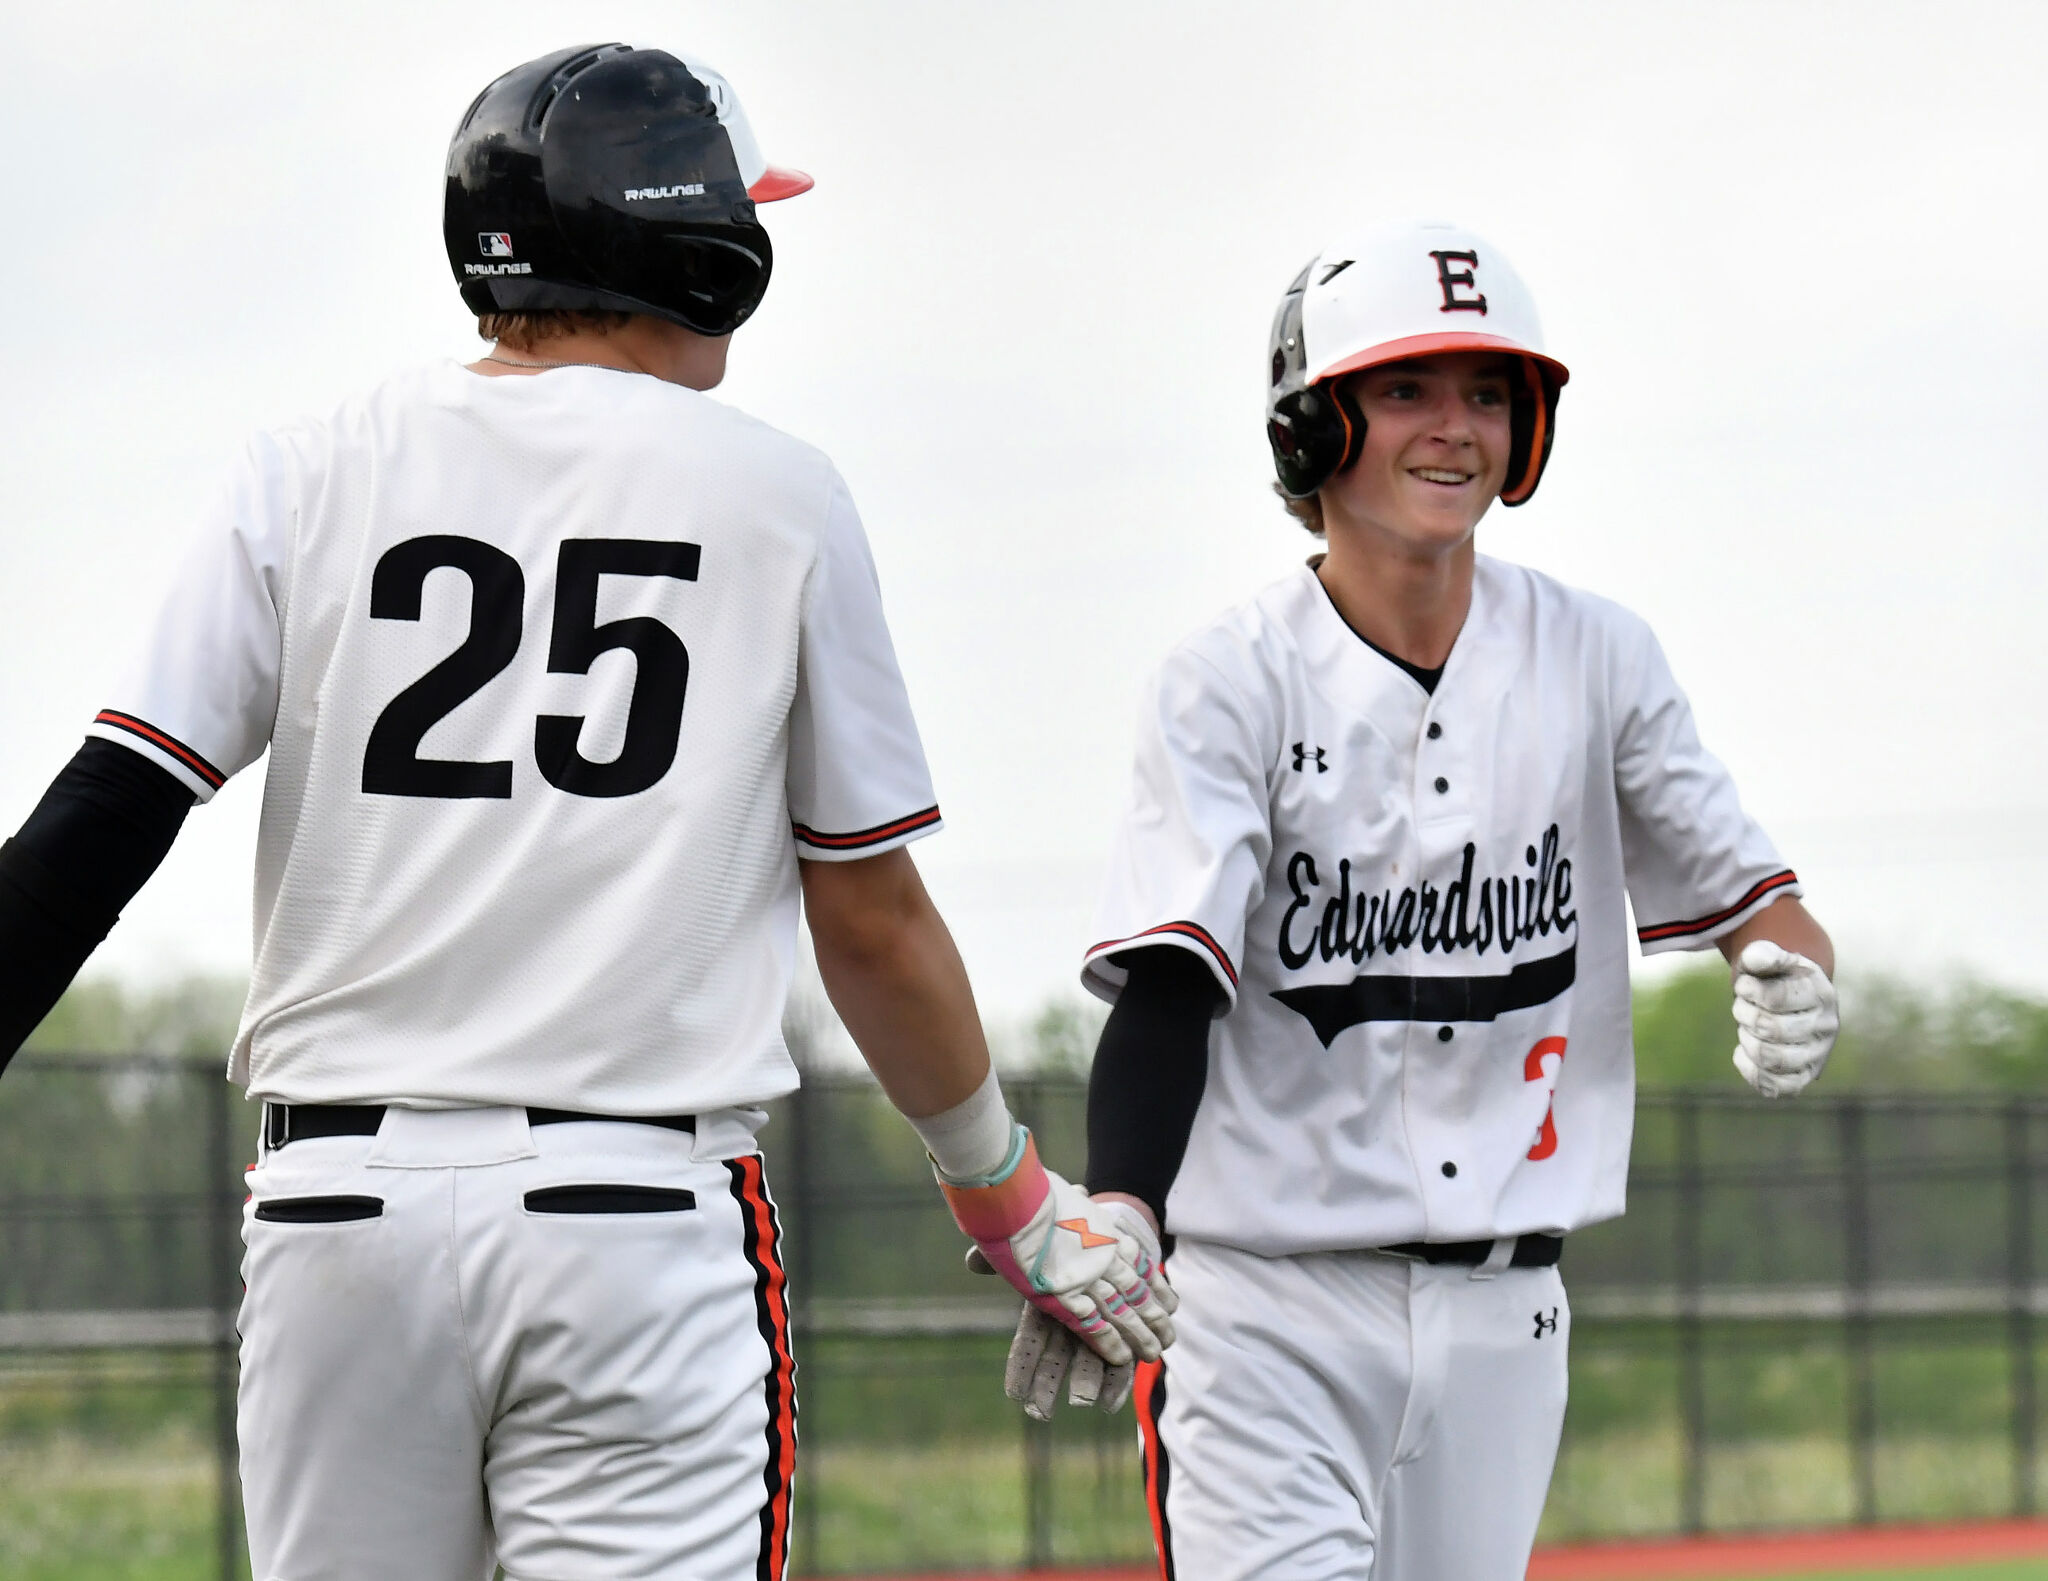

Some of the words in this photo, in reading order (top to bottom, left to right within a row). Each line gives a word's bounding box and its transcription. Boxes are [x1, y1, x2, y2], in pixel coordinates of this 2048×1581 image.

[624, 183, 706, 201] RAWLINGS
[464, 263, 533, 275] RAWLINGS
[1428, 249, 1488, 316] E
[361, 534, 702, 799] 25
